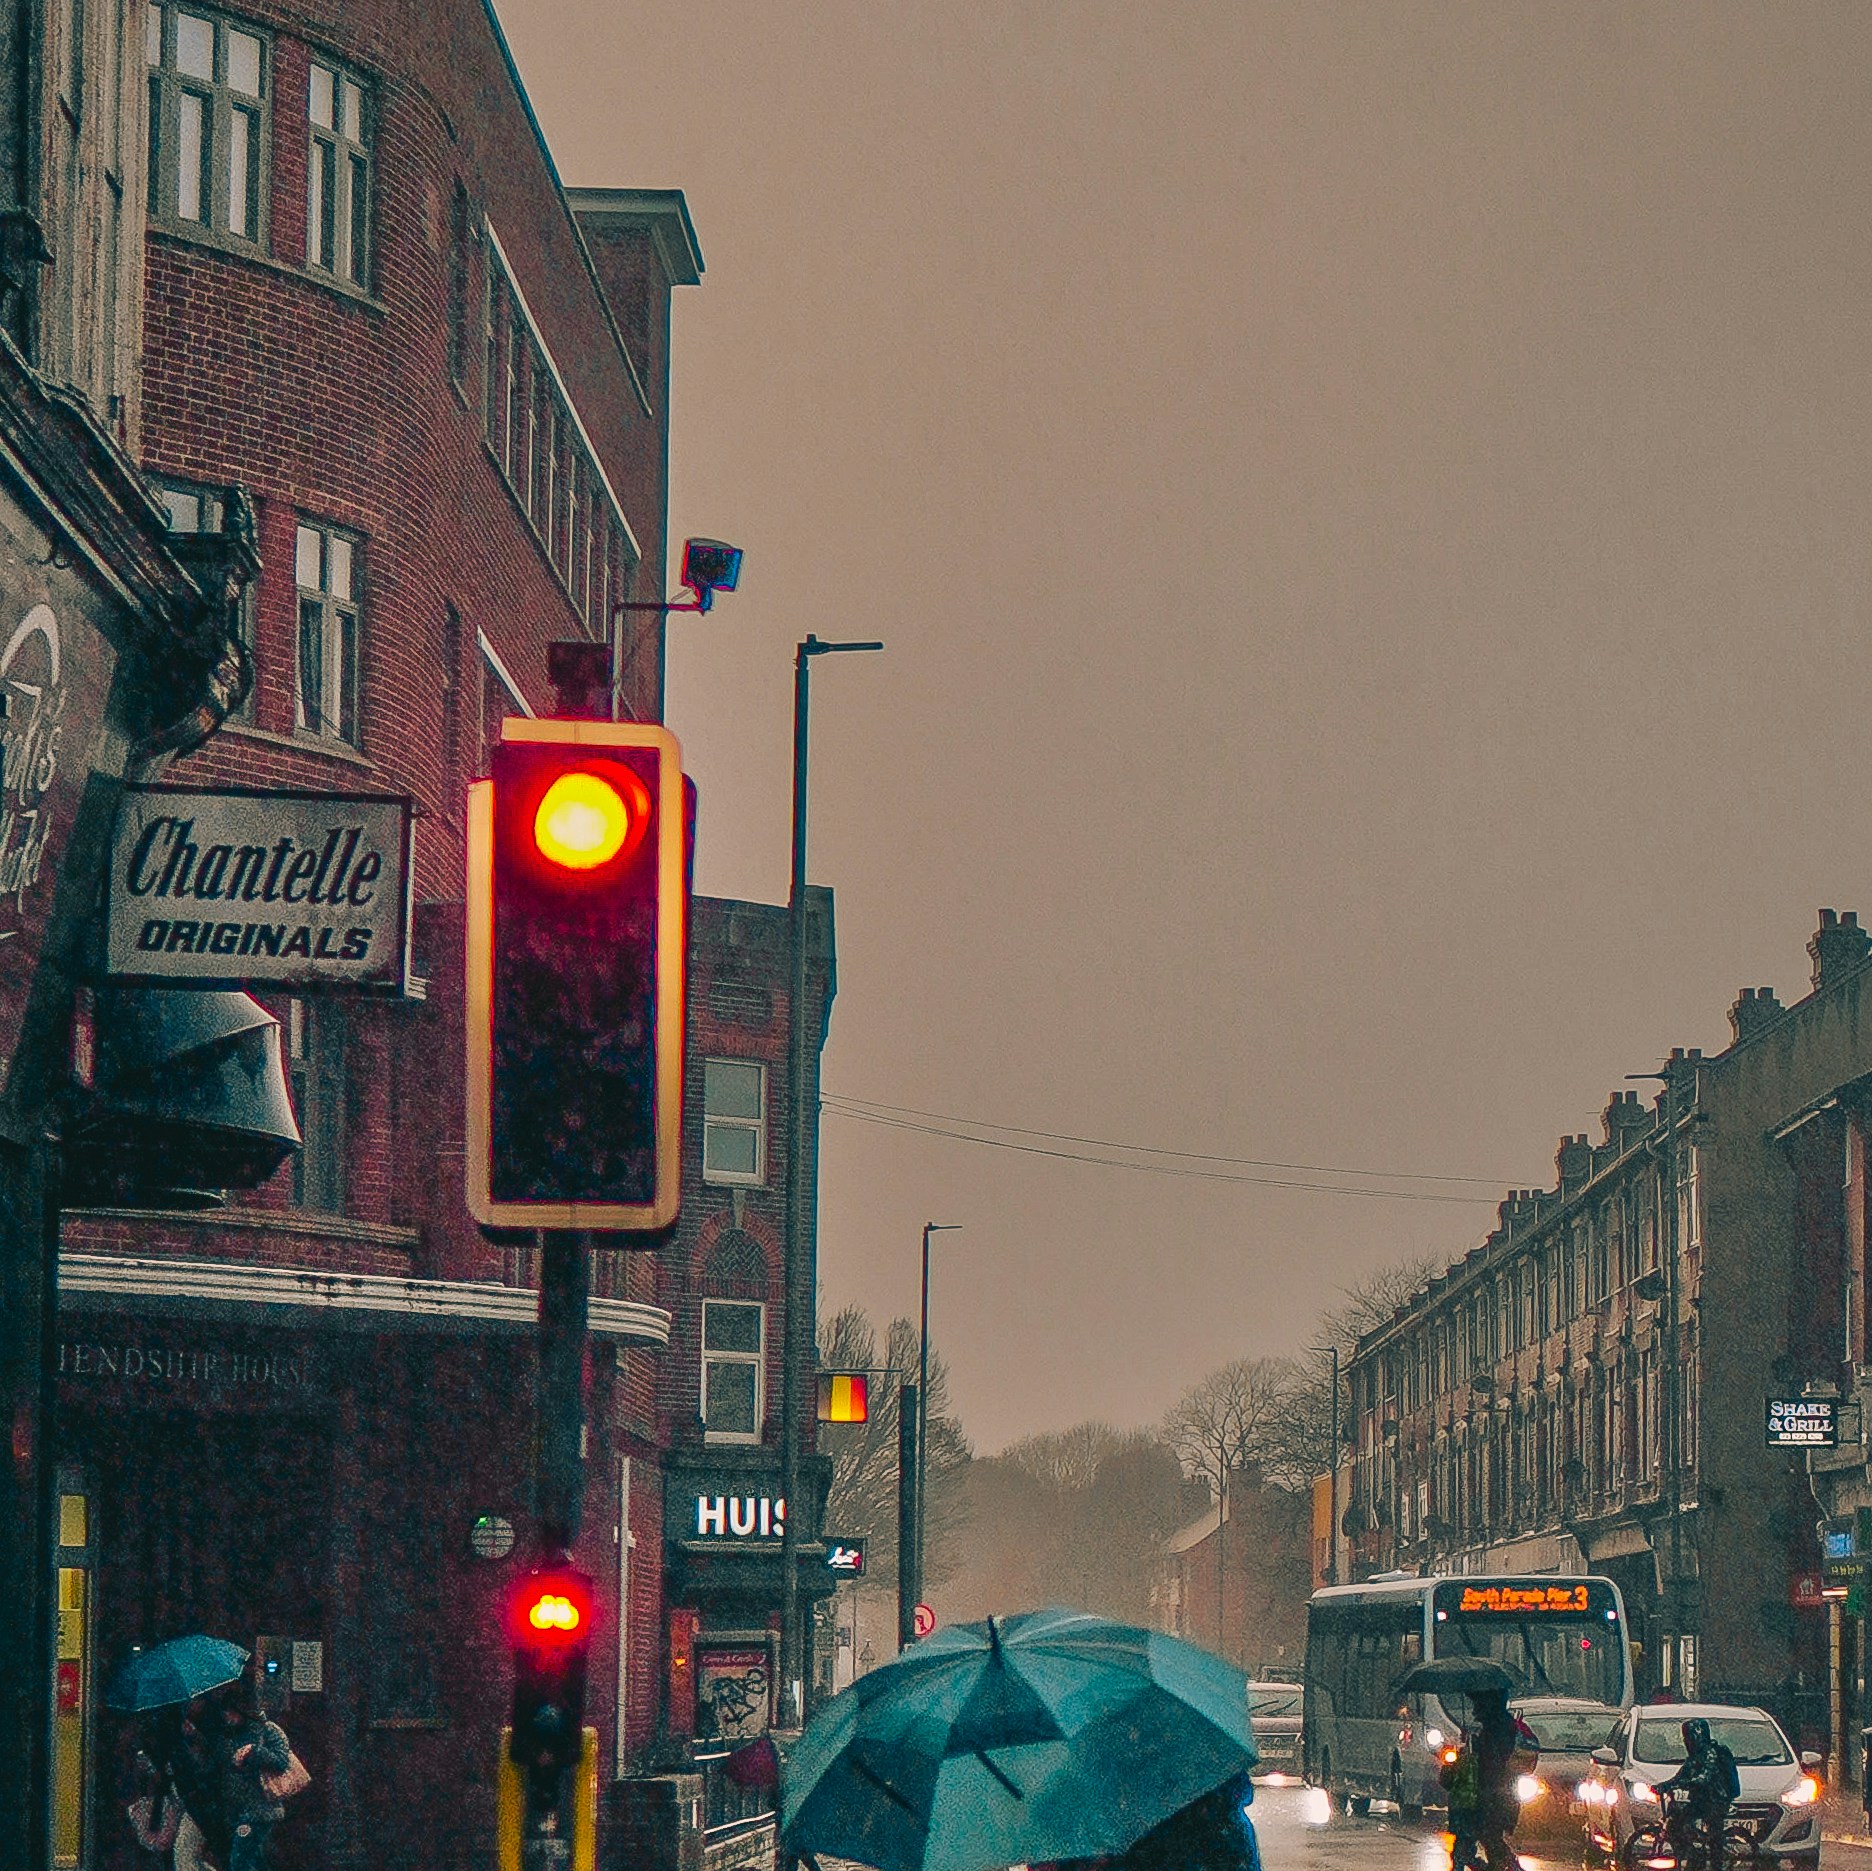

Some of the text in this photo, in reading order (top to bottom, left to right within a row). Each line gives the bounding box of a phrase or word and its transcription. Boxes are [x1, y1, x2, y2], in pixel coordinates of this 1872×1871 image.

[126, 815, 382, 906] Chantelle
[136, 919, 373, 960] ORIGINALS
[1574, 1585, 1588, 1611] 3
